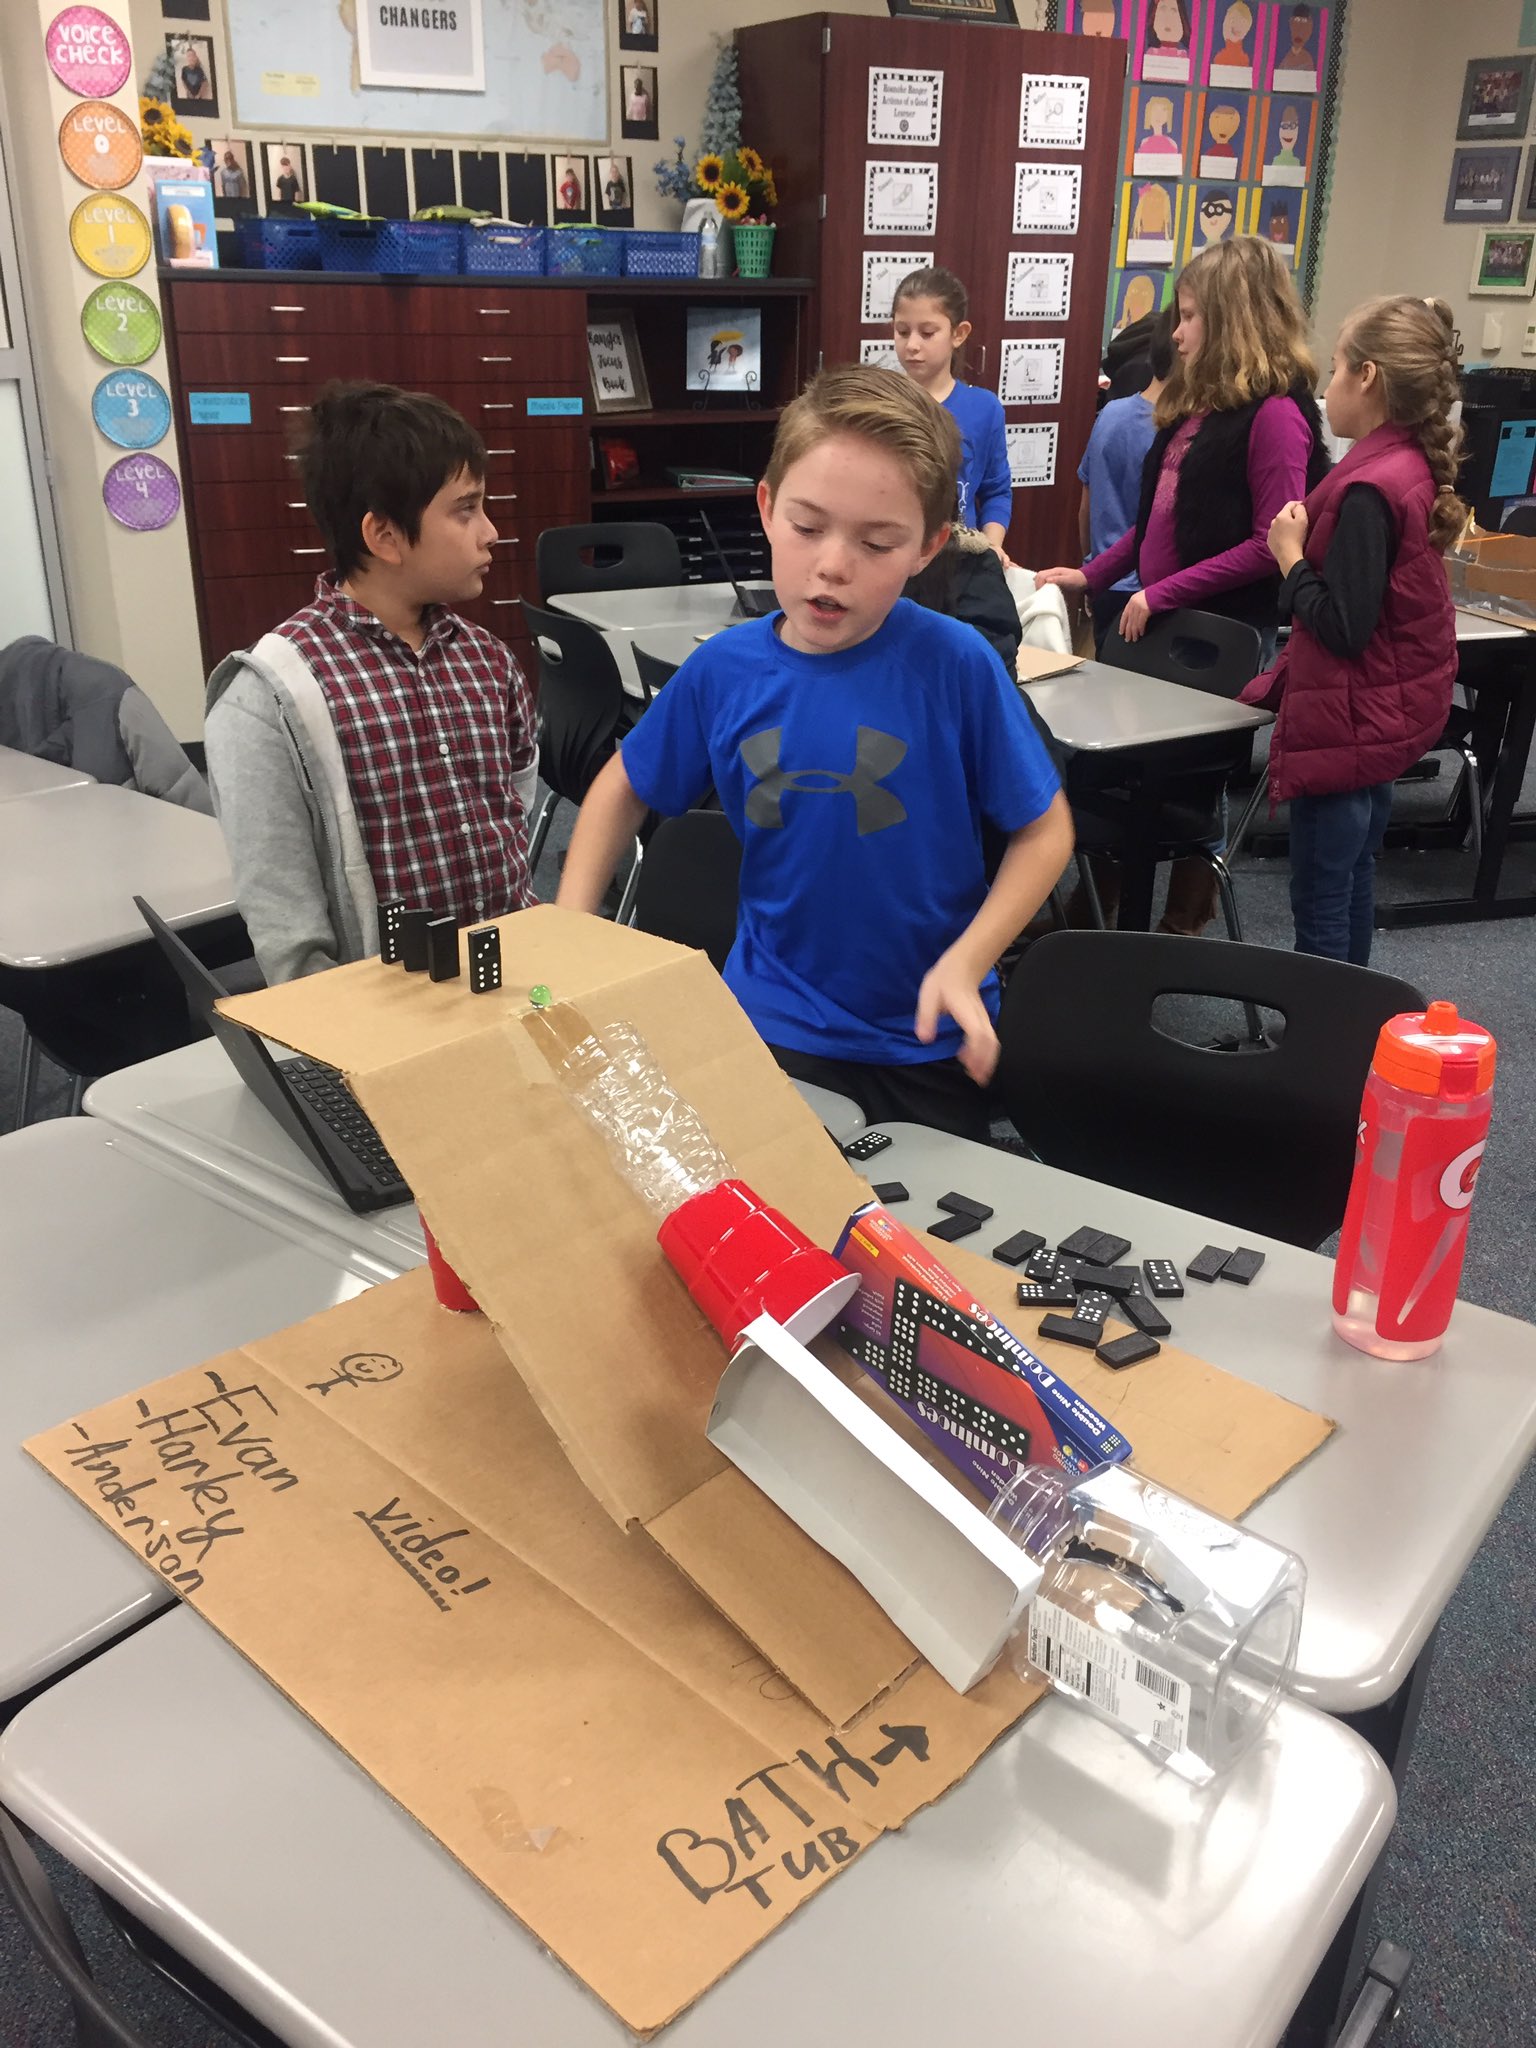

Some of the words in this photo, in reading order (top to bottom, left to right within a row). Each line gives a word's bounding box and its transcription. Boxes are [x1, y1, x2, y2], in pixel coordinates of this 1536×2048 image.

[379, 5, 457, 31] CHANGERS
[116, 313, 128, 332] 2
[127, 399, 139, 418] 3
[135, 480, 149, 499] 4
[964, 1300, 1056, 1387] Dominoes
[1050, 1387, 1071, 1408] Nine
[1070, 1406, 1101, 1436] Double
[1072, 1398, 1106, 1431] Wooden
[911, 1398, 1026, 1476] Dominoes
[971, 1459, 989, 1479] Nine
[656, 1735, 880, 1905] BATH
[723, 1826, 860, 1910] TUB
